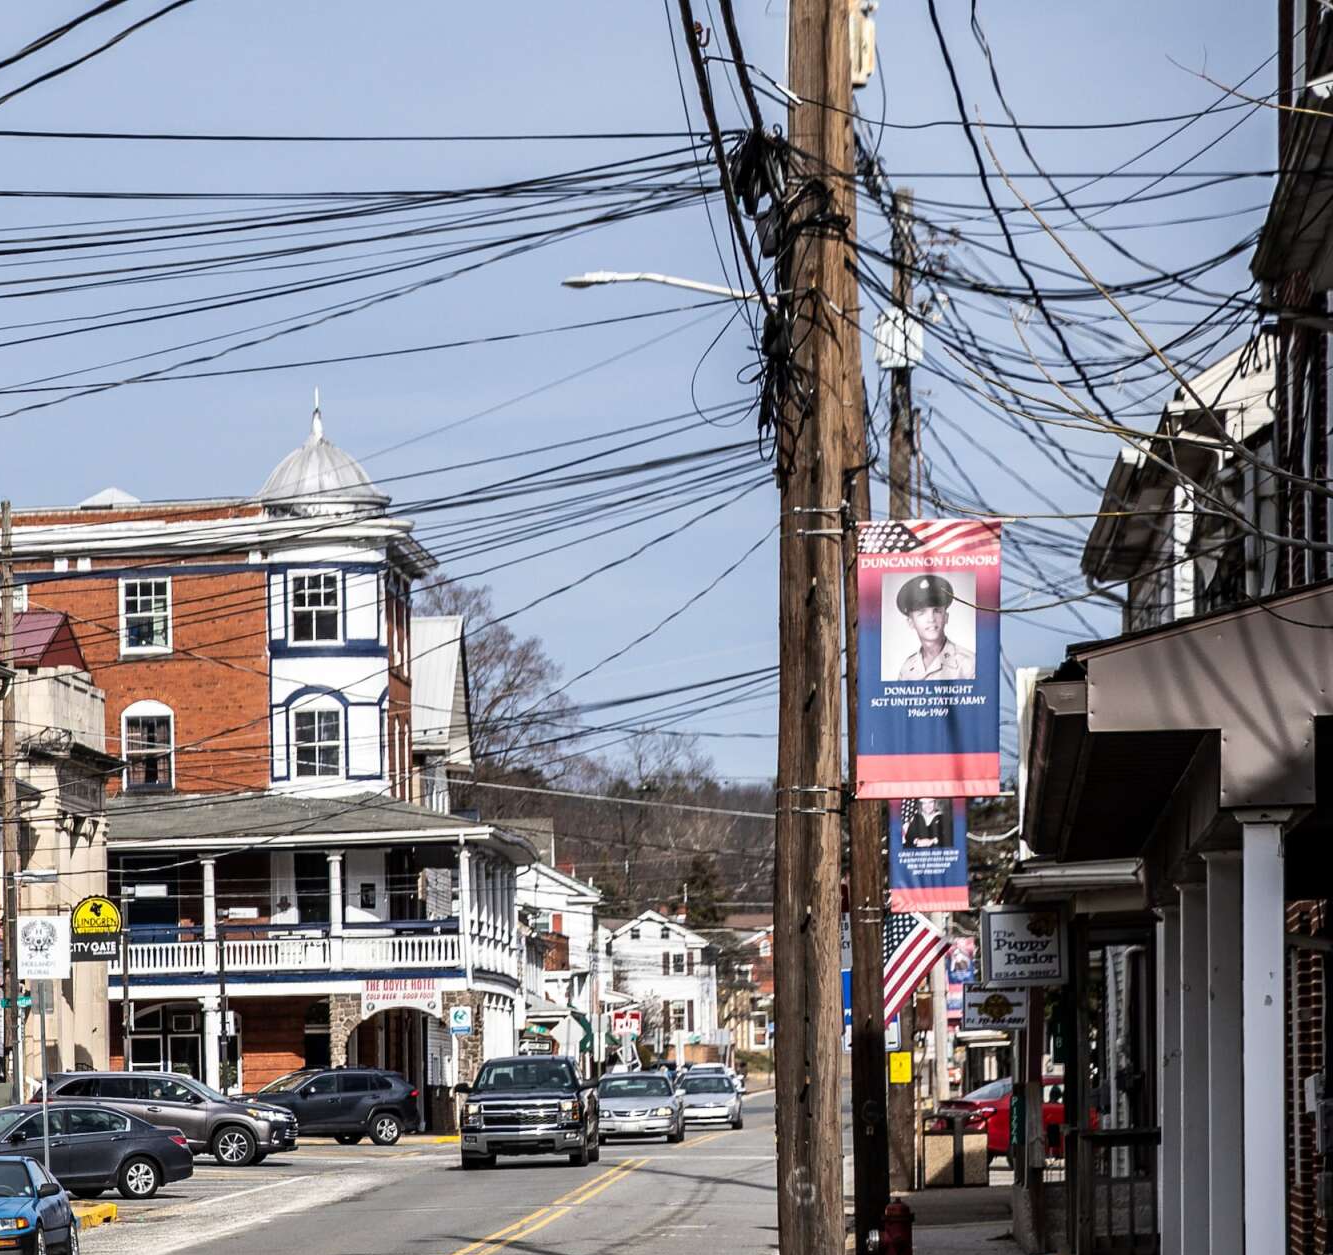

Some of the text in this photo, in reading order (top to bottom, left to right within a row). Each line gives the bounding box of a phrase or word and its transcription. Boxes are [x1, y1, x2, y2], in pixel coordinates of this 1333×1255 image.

[861, 554, 999, 569] DUNCANNON HONORS
[884, 686, 925, 696] DONALD
[933, 685, 974, 695] WRIGHT
[871, 696, 987, 707] SGT UNITED STATES ARMY
[908, 708, 949, 717] 1966-1969
[70, 941, 117, 953] CITY GATE
[994, 938, 1053, 952] Puppy
[1005, 953, 1057, 965] Parlor
[365, 978, 436, 991] THE DOYLE HOTEL
